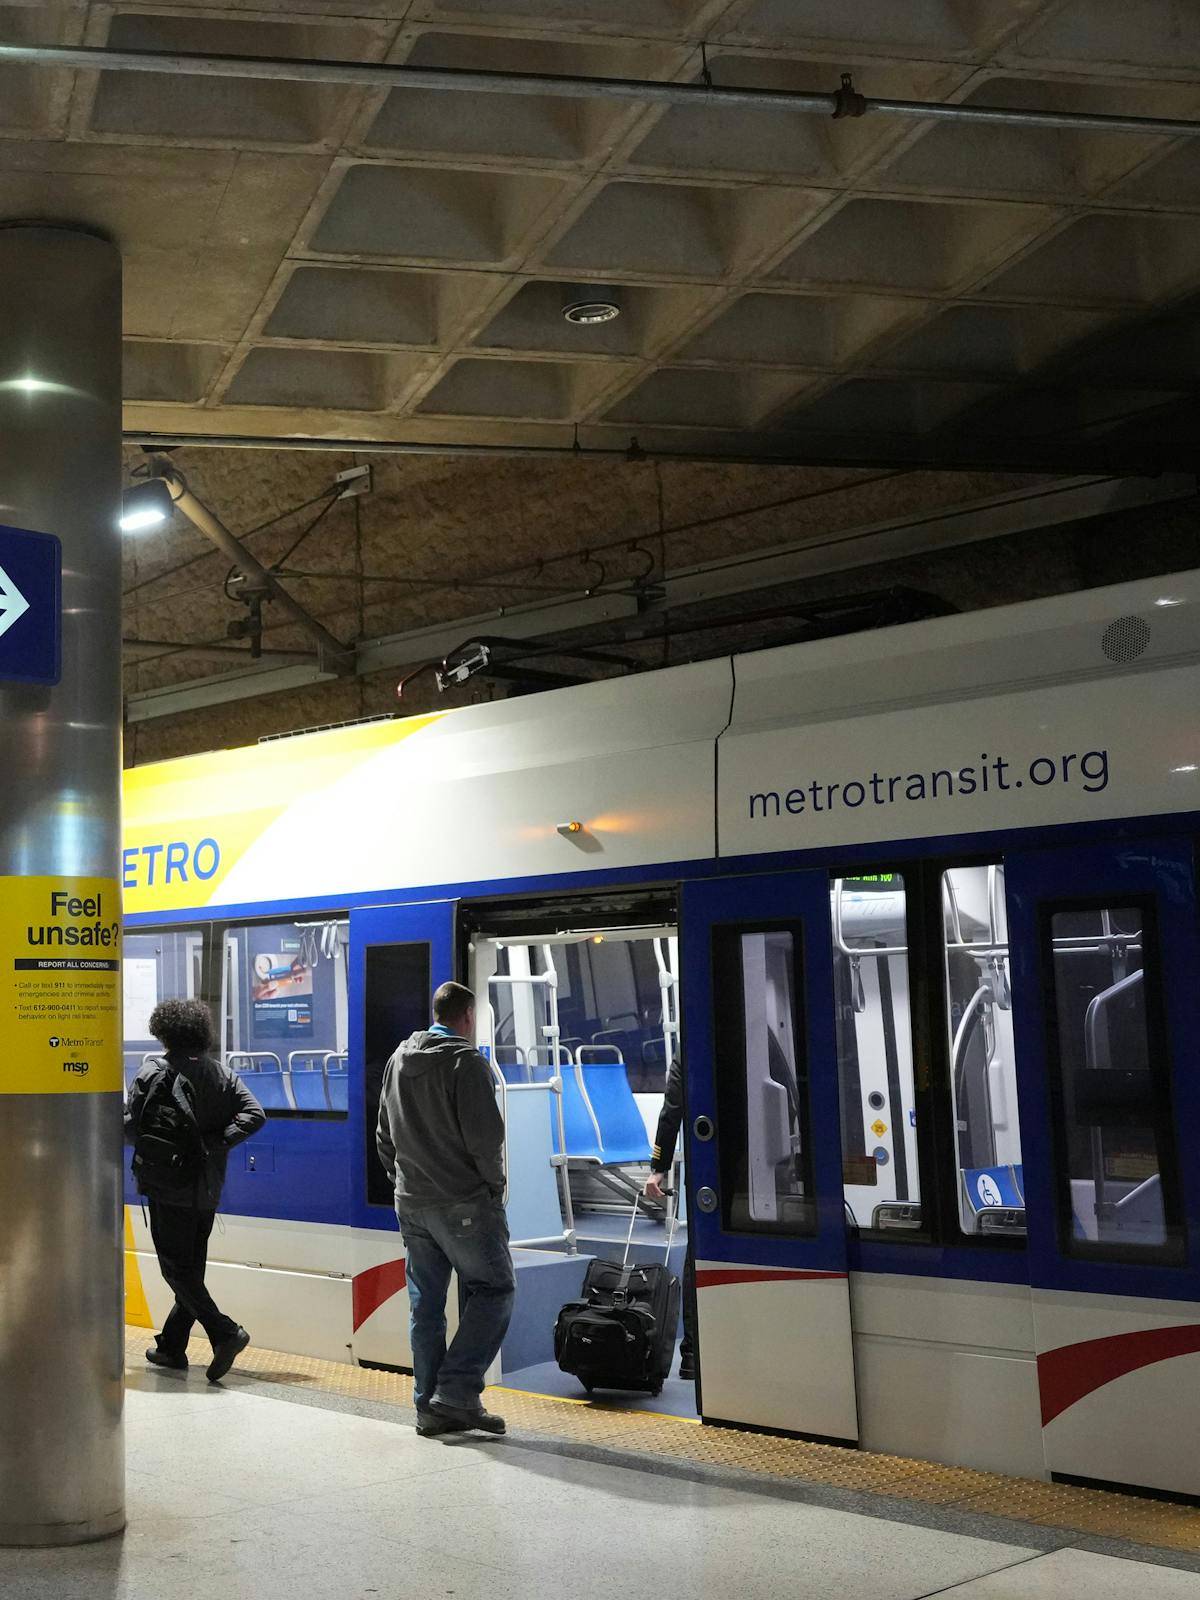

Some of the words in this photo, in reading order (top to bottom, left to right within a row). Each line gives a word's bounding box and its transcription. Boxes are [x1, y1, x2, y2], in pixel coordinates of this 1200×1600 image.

[749, 750, 1109, 818] metrotransit.org
[51, 891, 102, 917] Feel
[27, 921, 119, 947] unsafe?
[63, 1062, 89, 1074] msp
